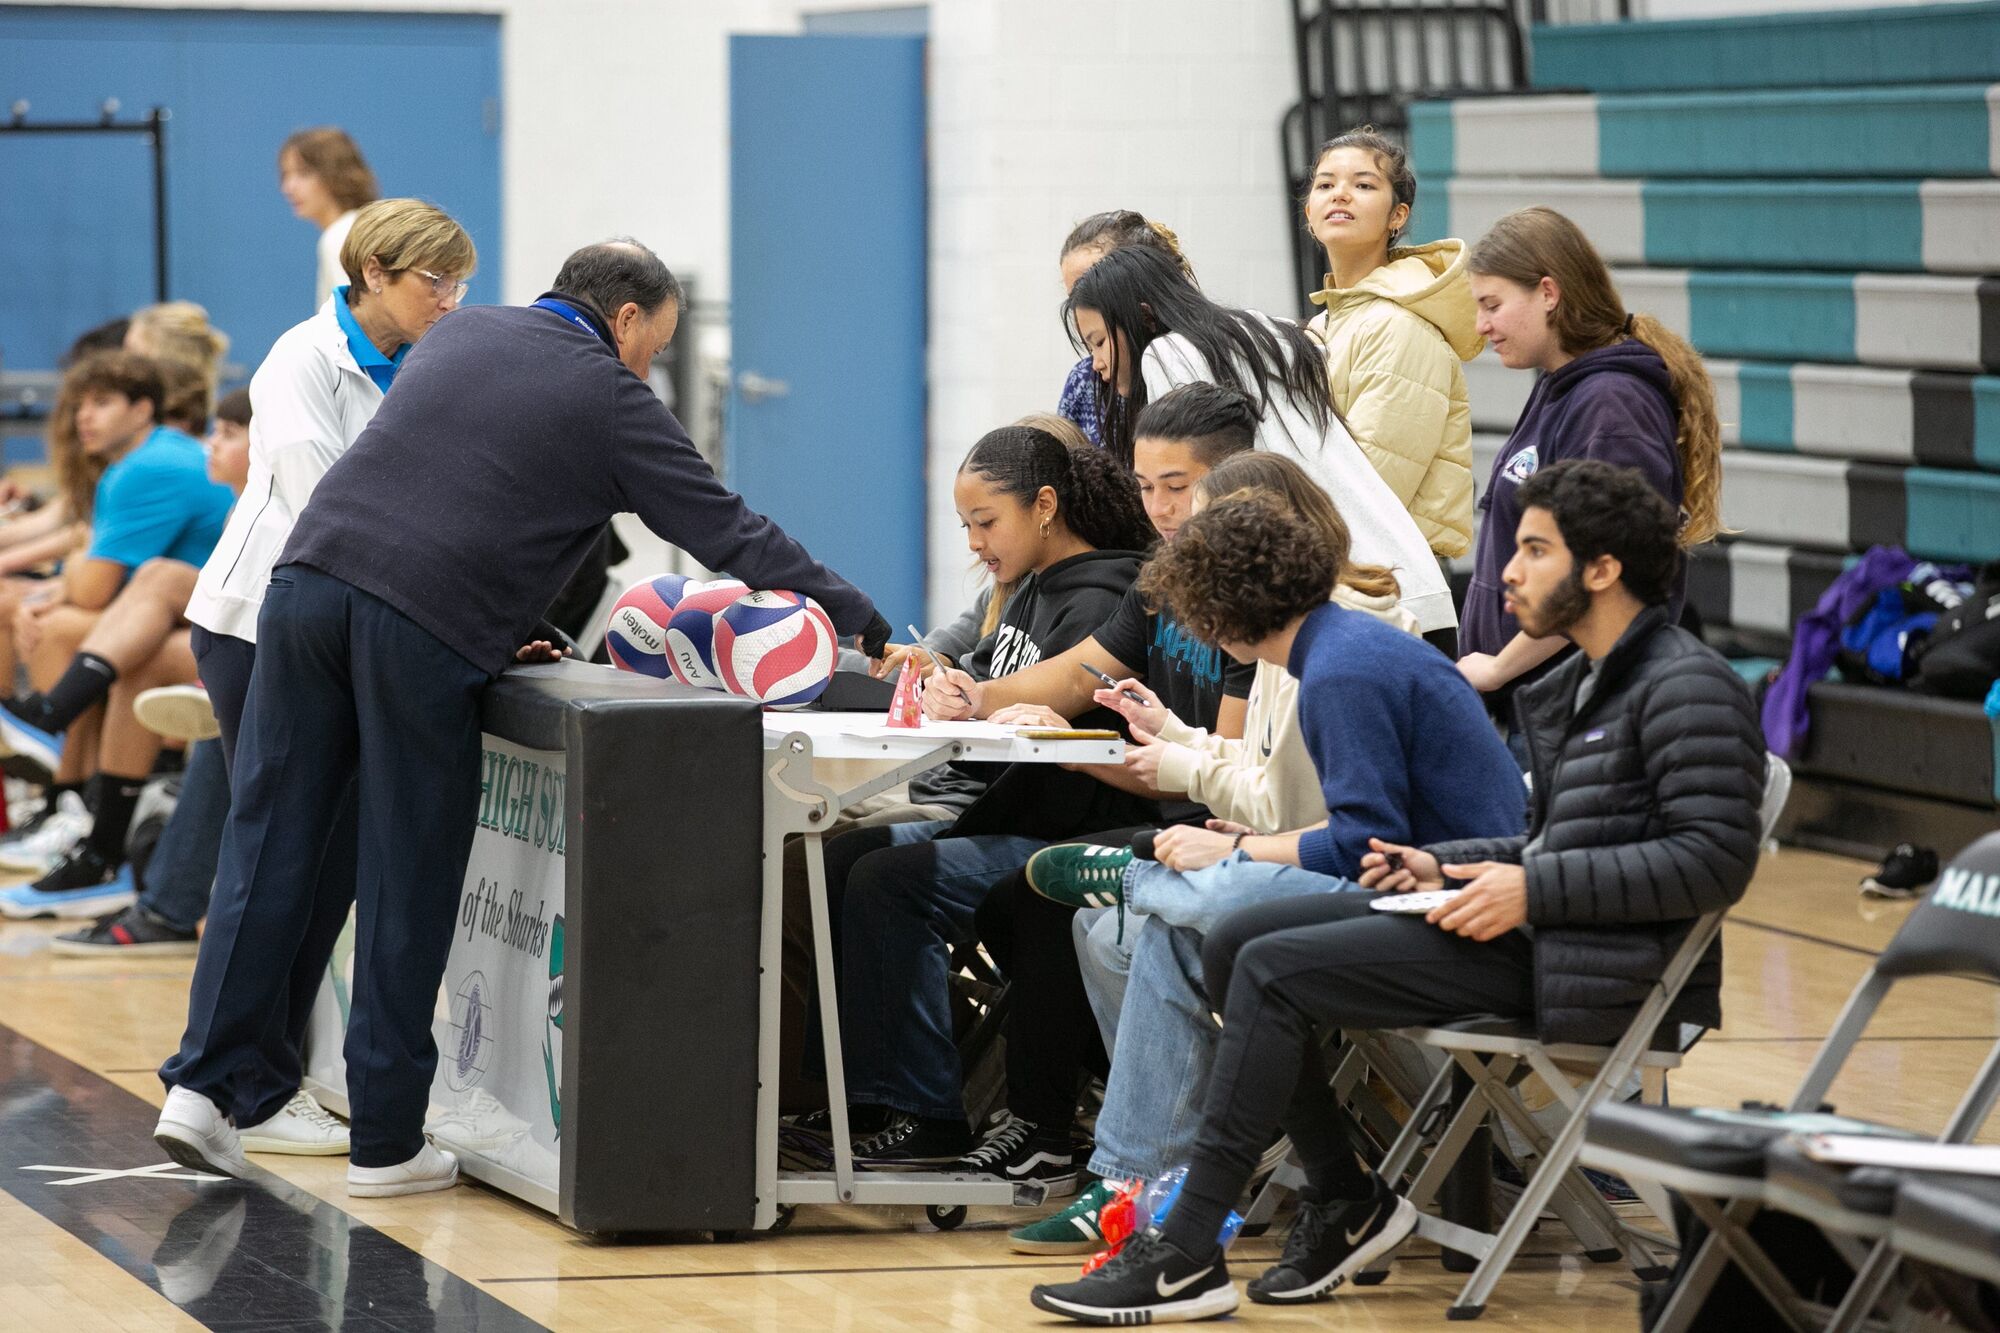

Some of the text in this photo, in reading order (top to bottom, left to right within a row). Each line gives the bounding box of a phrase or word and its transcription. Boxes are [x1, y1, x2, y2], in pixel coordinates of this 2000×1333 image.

[622, 610, 660, 650] molten
[680, 652, 702, 679] AAU
[478, 749, 540, 843] HIGH
[462, 876, 549, 959] of the Sharks
